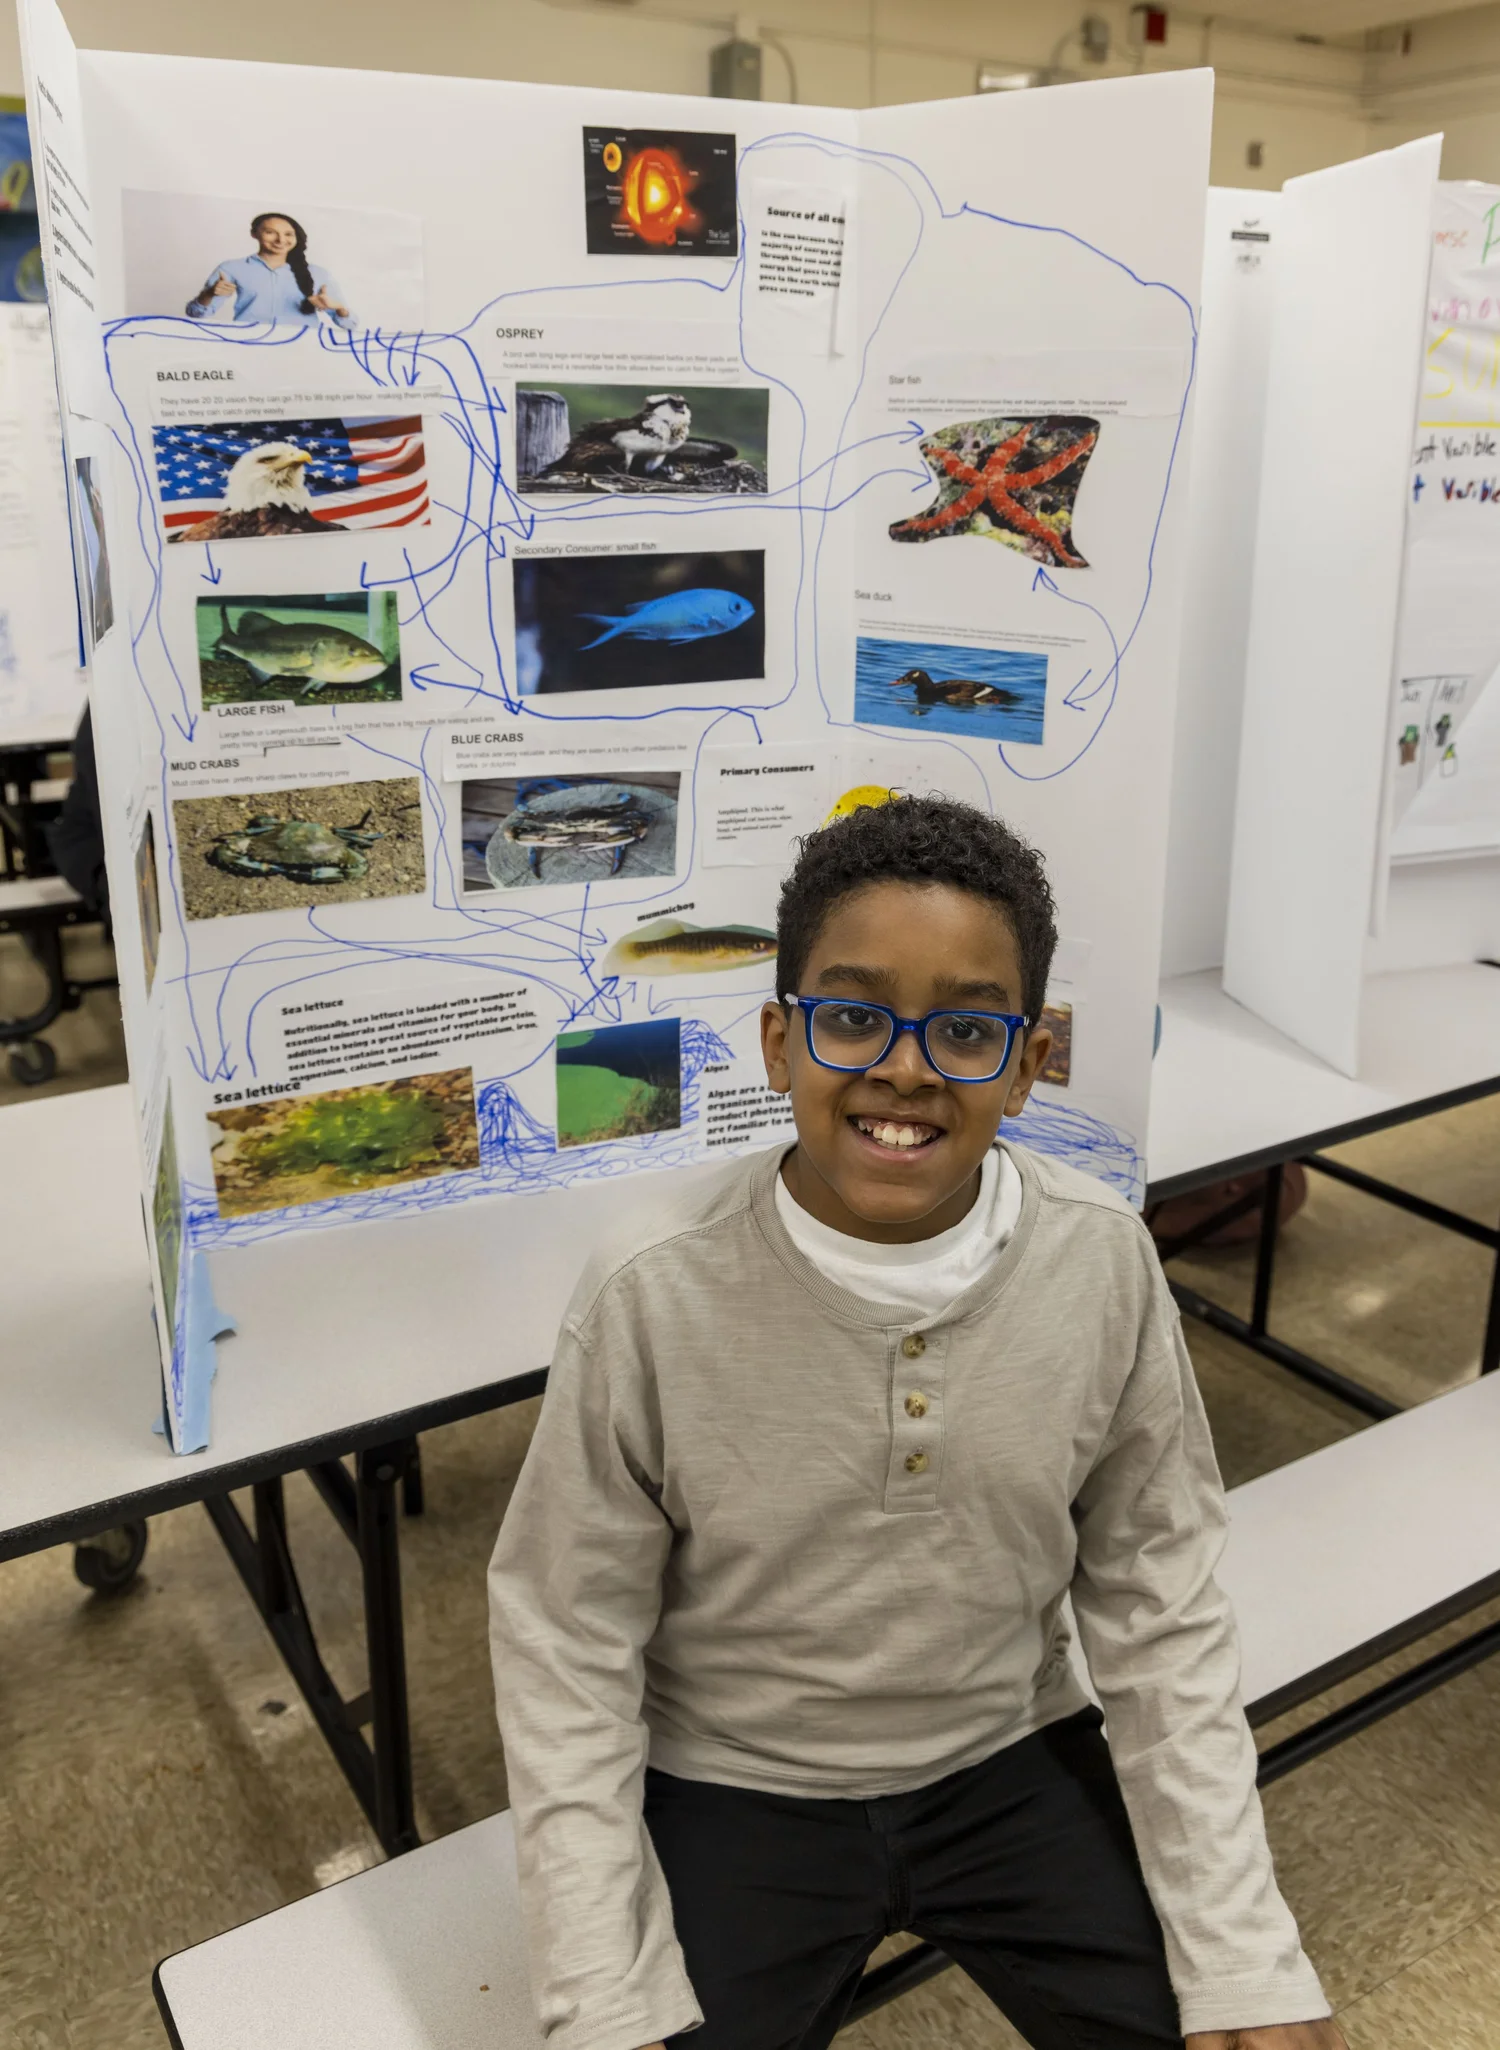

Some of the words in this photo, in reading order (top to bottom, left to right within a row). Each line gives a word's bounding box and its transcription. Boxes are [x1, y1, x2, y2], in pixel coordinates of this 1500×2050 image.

[767, 206, 802, 219] Source
[804, 212, 815, 220] of
[818, 214, 830, 222] all
[496, 327, 544, 339] OSPREY
[156, 371, 190, 382] BALD
[193, 370, 234, 381] EAGLE
[514, 545, 563, 555] Secondary
[616, 542, 639, 551] small
[641, 541, 657, 551] fish
[854, 589, 871, 600] Sea
[873, 591, 892, 601] duck
[217, 706, 257, 718] LARGE
[260, 704, 285, 715] FISH
[451, 734, 481, 745] BLUE
[484, 732, 525, 744] CRABS
[170, 760, 197, 772] MUD
[199, 758, 241, 770] CRABS
[720, 767, 760, 777] Primary
[762, 764, 815, 774] Consumers
[636, 902, 695, 921] mummichog
[281, 1006, 302, 1016] Sea
[304, 999, 344, 1012] lettuce
[352, 1016, 369, 1025] sea
[370, 1009, 404, 1021] lettuce
[405, 1007, 414, 1016] is
[416, 1001, 448, 1013] loaded
[449, 997, 470, 1008] with
[479, 990, 515, 1002] number
[517, 988, 527, 997] of
[285, 1033, 331, 1048] essential
[332, 1026, 375, 1040] minerals
[377, 1022, 396, 1032] and
[397, 1016, 438, 1029] vitamins
[440, 1011, 455, 1021] for
[457, 1008, 479, 1019] your
[287, 1046, 328, 1060] addition
[330, 1043, 340, 1053] to
[342, 1039, 369, 1051] being
[378, 1032, 404, 1045] great
[406, 1027, 438, 1039] source
[440, 1023, 451, 1033] of
[453, 1016, 498, 1030] vegetable
[288, 1063, 306, 1072] sea
[307, 1056, 341, 1068] lettuce
[343, 1048, 385, 1062] contains
[400, 1035, 450, 1051] abundance
[452, 1033, 462, 1042] of
[213, 1092, 242, 1105] Sea
[245, 1081, 301, 1099] lettuce
[708, 1088, 737, 1099] Algae
[739, 1086, 757, 1095] are
[707, 1098, 762, 1111] organisms
[764, 1093, 786, 1103] that
[707, 1110, 748, 1123] conduct
[706, 1127, 725, 1136] are
[727, 1119, 769, 1132] familiar
[771, 1117, 782, 1126] to
[706, 1134, 751, 1147] instance
